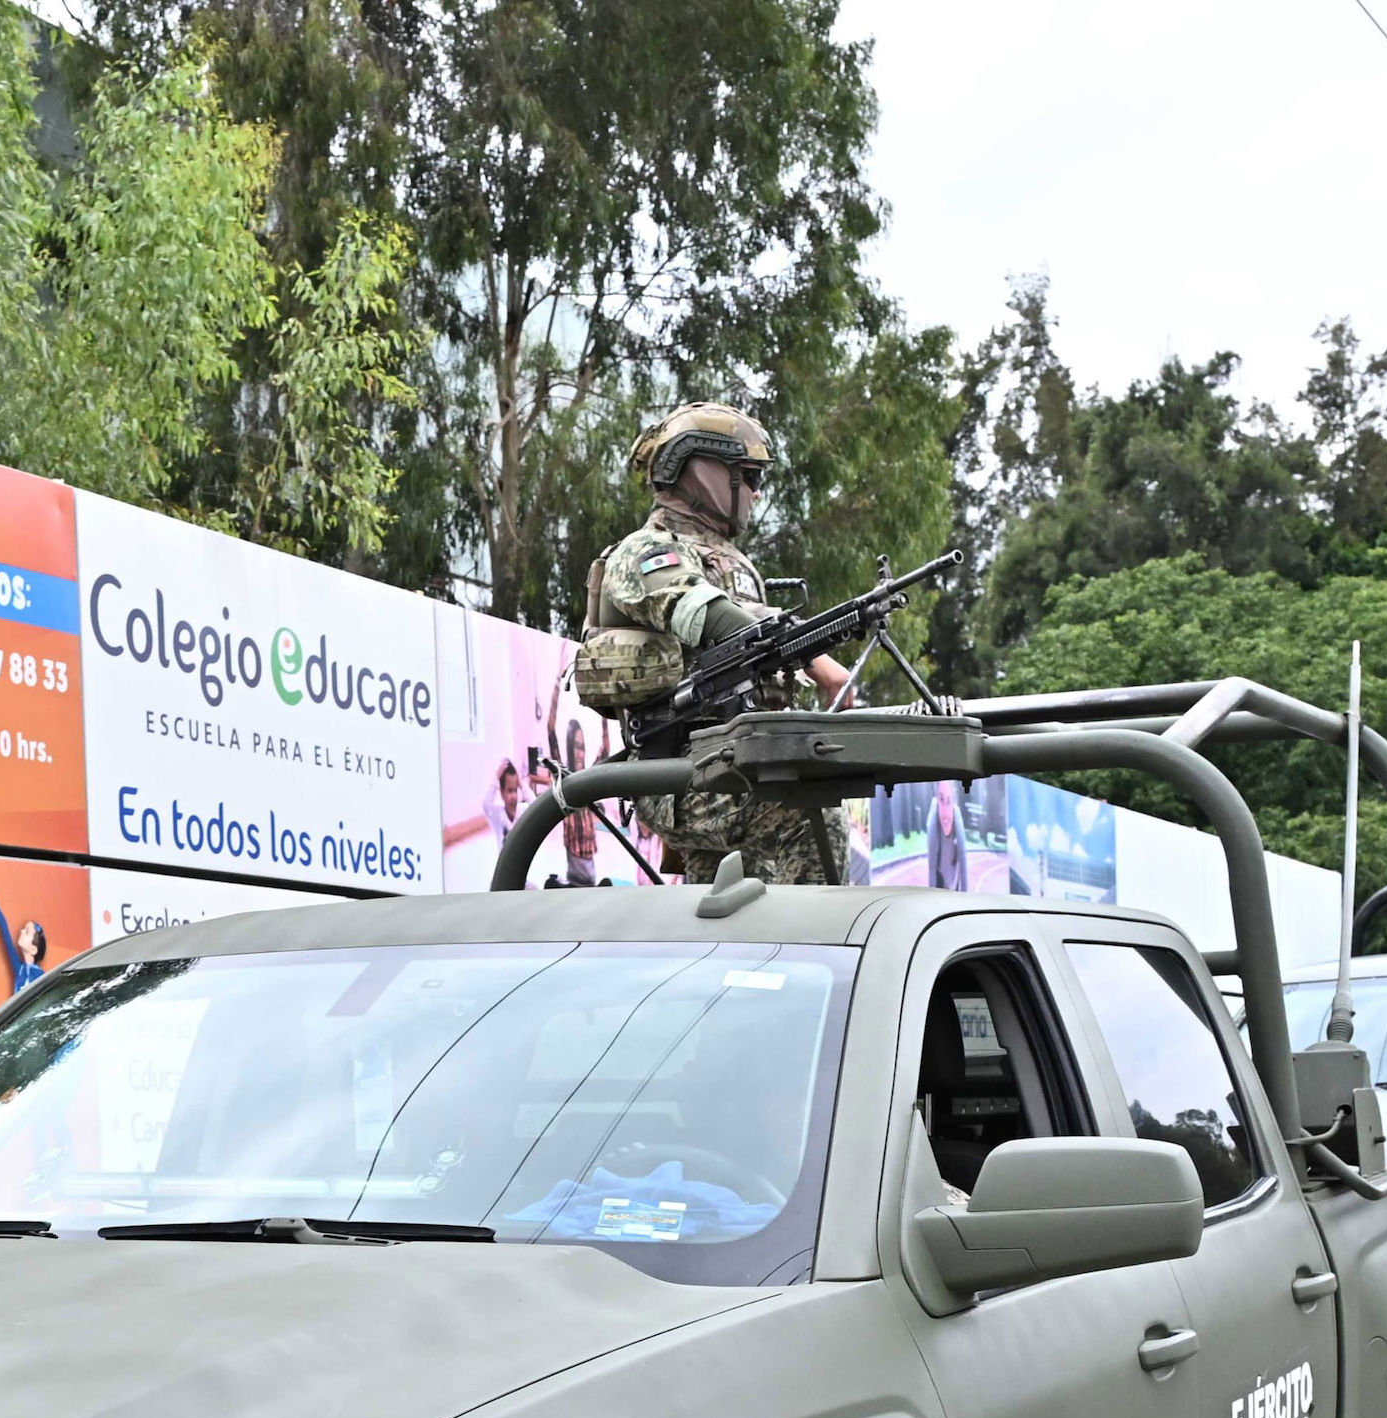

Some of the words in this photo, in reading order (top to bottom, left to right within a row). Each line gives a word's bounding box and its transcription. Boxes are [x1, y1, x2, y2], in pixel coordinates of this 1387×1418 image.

[9, 652, 38, 687] 88
[42, 658, 69, 693] 33
[89, 573, 262, 707] Colegio
[270, 626, 431, 728] educare
[16, 731, 53, 764] hrs.
[145, 710, 241, 751] ESCUELA
[252, 732, 303, 763] PARA
[313, 745, 334, 769] EL
[344, 746, 396, 781] ÉXITO
[118, 786, 162, 847] En
[172, 799, 261, 861] todos
[269, 809, 313, 868] los
[321, 820, 422, 882] niveles:
